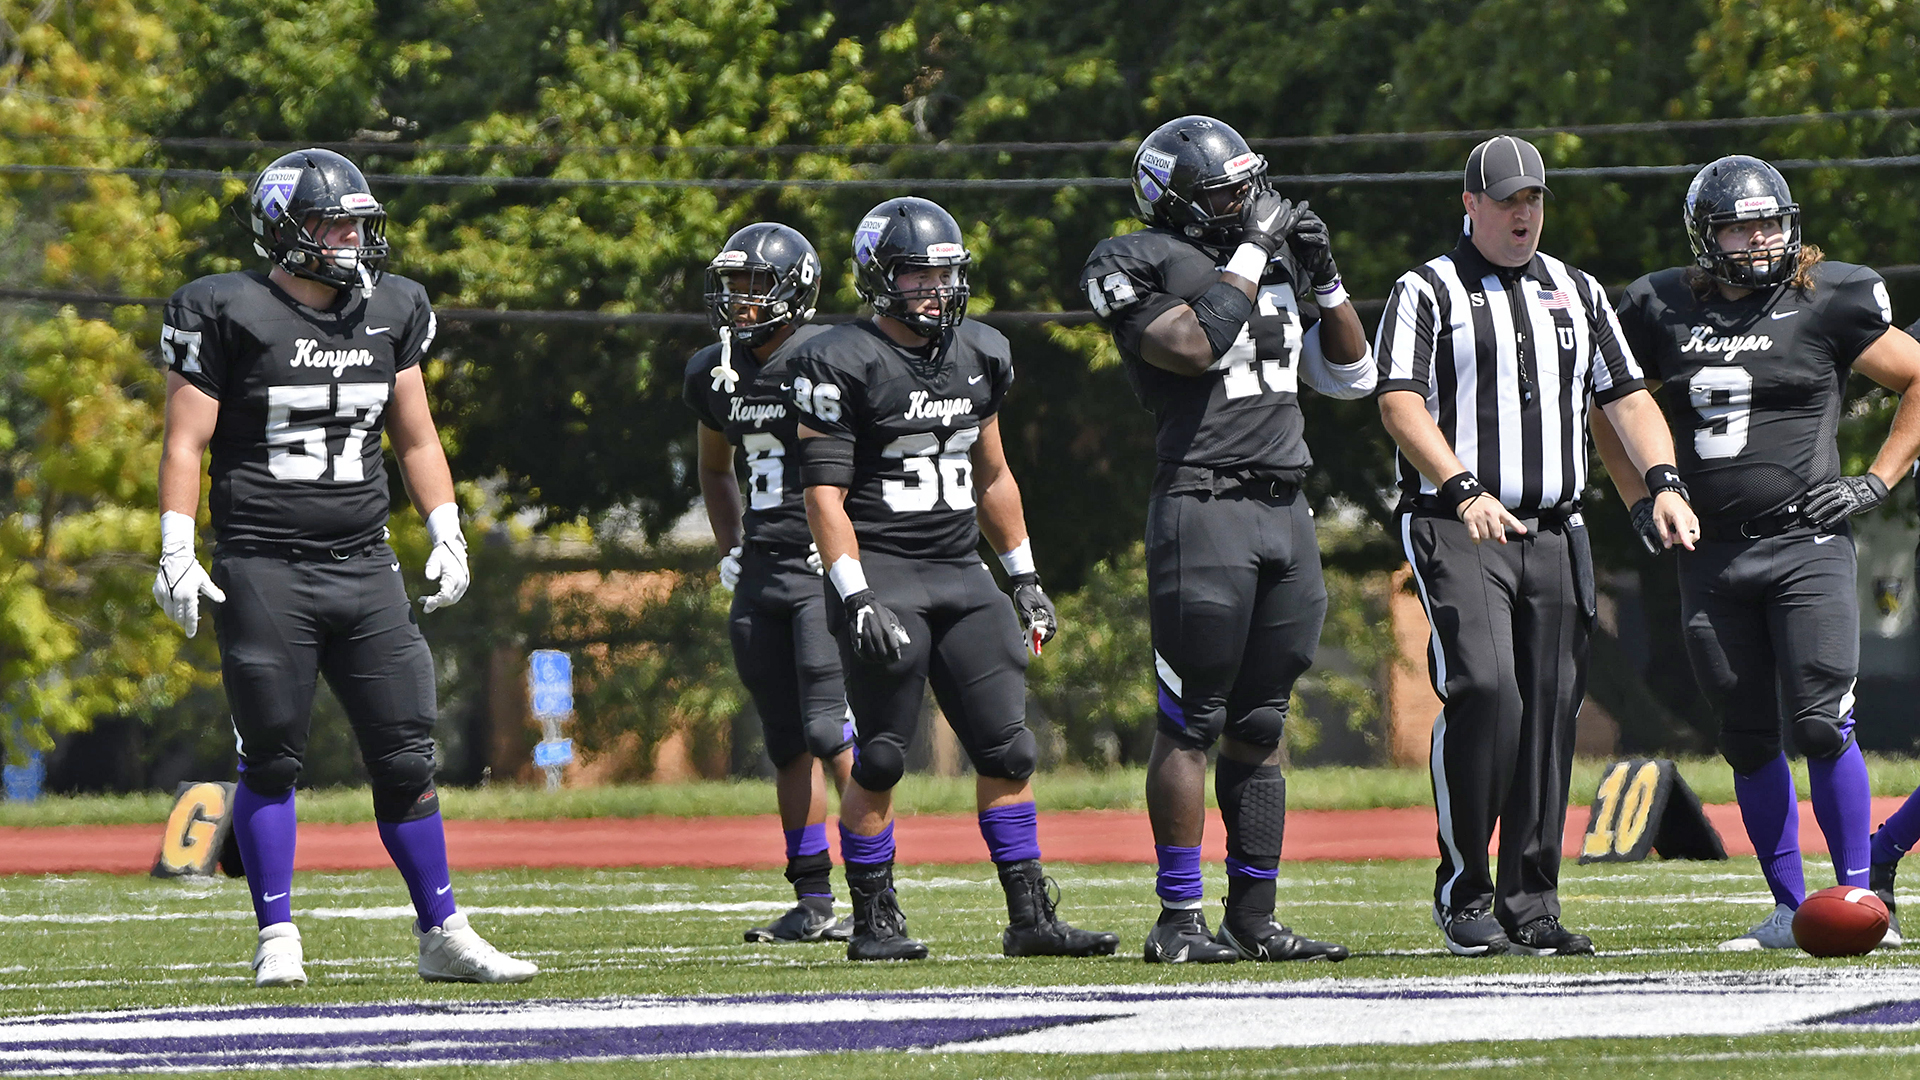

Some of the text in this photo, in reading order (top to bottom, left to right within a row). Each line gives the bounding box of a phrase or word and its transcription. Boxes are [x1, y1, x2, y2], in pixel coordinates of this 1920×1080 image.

[266, 173, 295, 181] KENYON
[1144, 153, 1171, 168] KENYON
[801, 252, 814, 285] 6
[1470, 292, 1485, 307] S
[1873, 281, 1892, 323] 9
[161, 323, 202, 372] 57
[290, 338, 374, 378] Kenyon
[1557, 327, 1573, 350] U
[1680, 325, 1773, 362] Kenyon
[727, 397, 787, 429] Kenyon
[793, 376, 842, 422] 36
[903, 390, 973, 427] Kenyon
[1690, 366, 1754, 460] 9
[266, 382, 389, 482] 57
[880, 425, 980, 513] 36
[162, 782, 226, 872] G
[1582, 760, 1660, 857] 10
